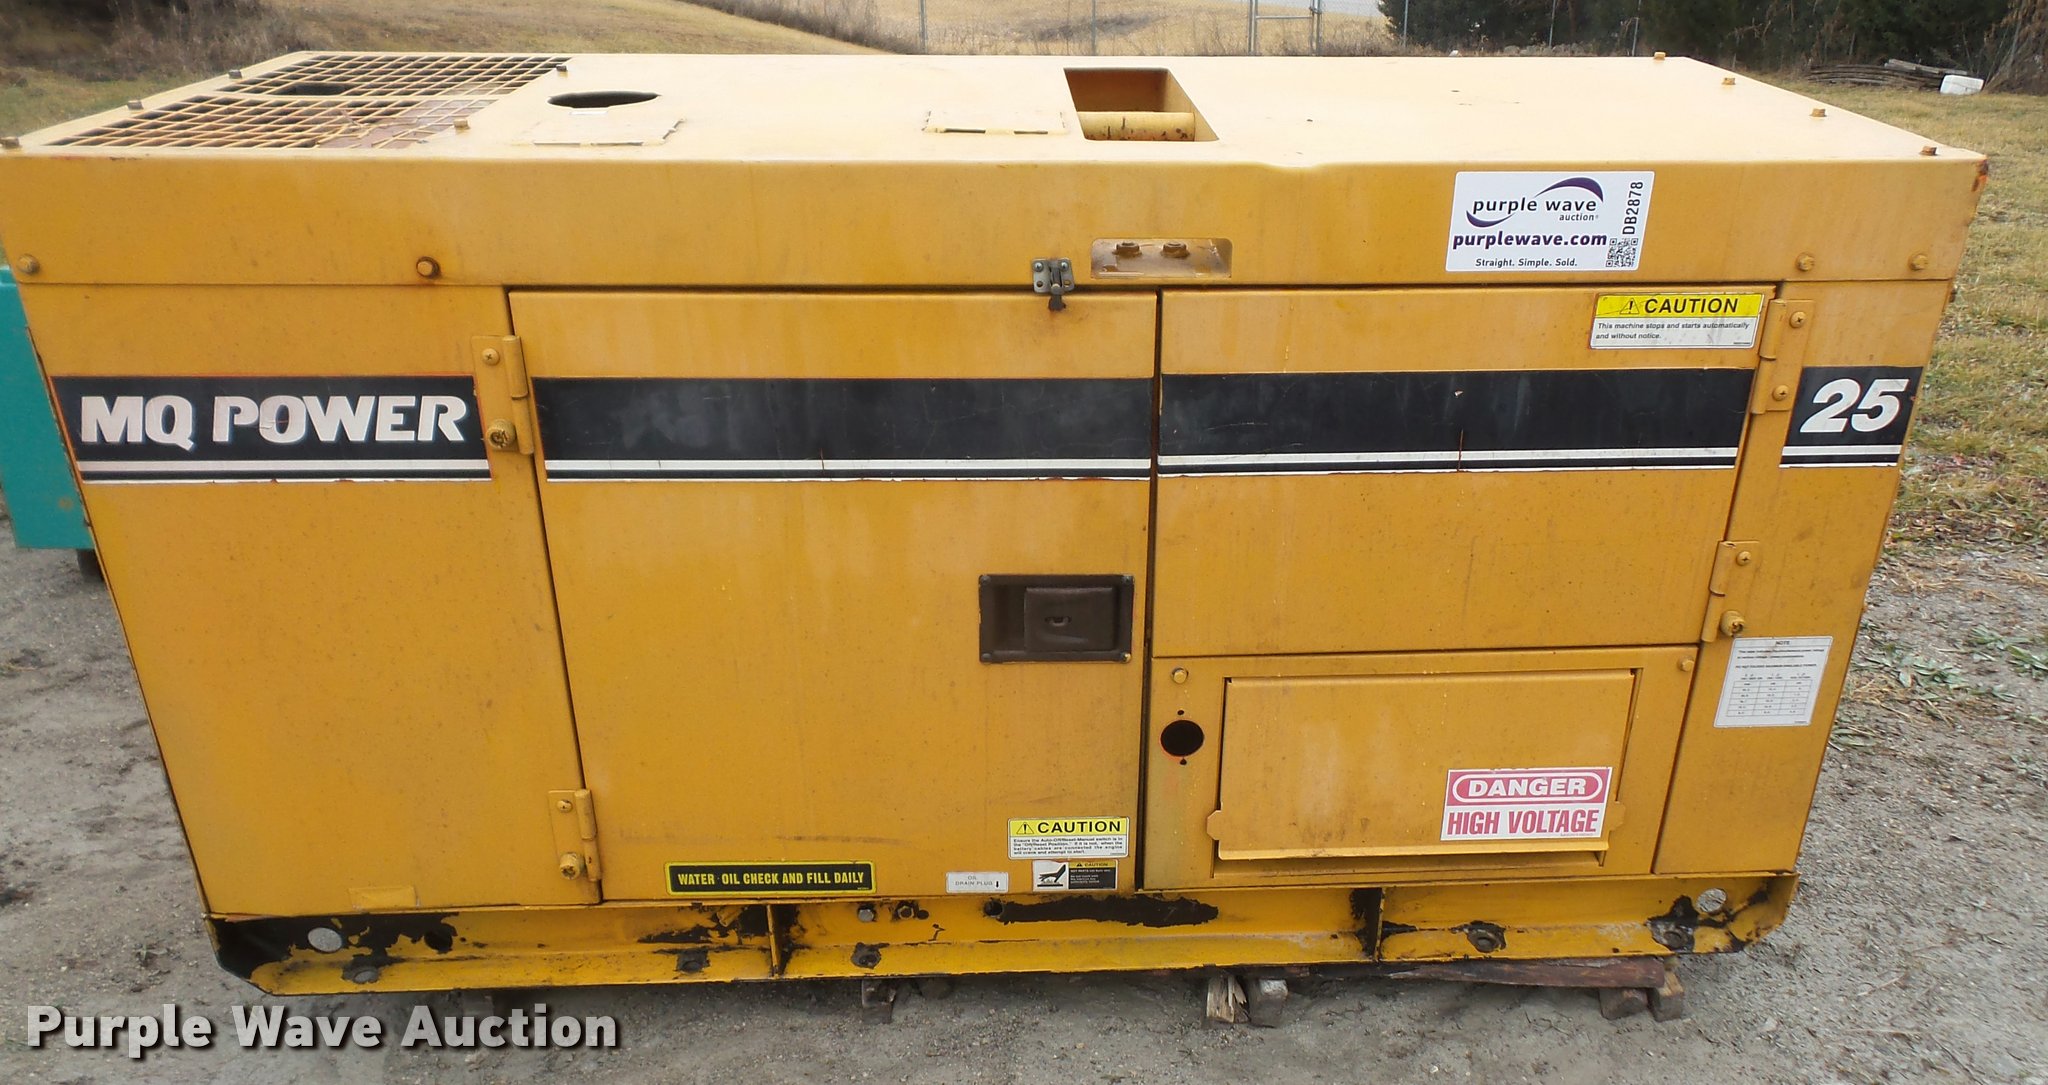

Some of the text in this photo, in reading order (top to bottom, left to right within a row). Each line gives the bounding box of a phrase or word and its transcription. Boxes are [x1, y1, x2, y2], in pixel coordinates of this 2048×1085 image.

[1473, 197, 1597, 215] purple wave
[1622, 181, 1644, 235] DB2878
[1452, 231, 1608, 250] purplewave.com
[1475, 258, 1578, 268] Straight. Simple. Sold.
[1644, 298, 1739, 314] CAUTION
[1645, 322, 1665, 330] stops
[1702, 322, 1750, 330] automatically
[1800, 378, 1910, 433] 25
[80, 395, 468, 451] MQ POWER
[1468, 778, 1587, 797] DANGER
[1037, 821, 1121, 834] CAUTION
[1447, 809, 1600, 835] HIGH VOLTAGE
[678, 872, 864, 886] WATER OIL CHECK AND FILL DAILY
